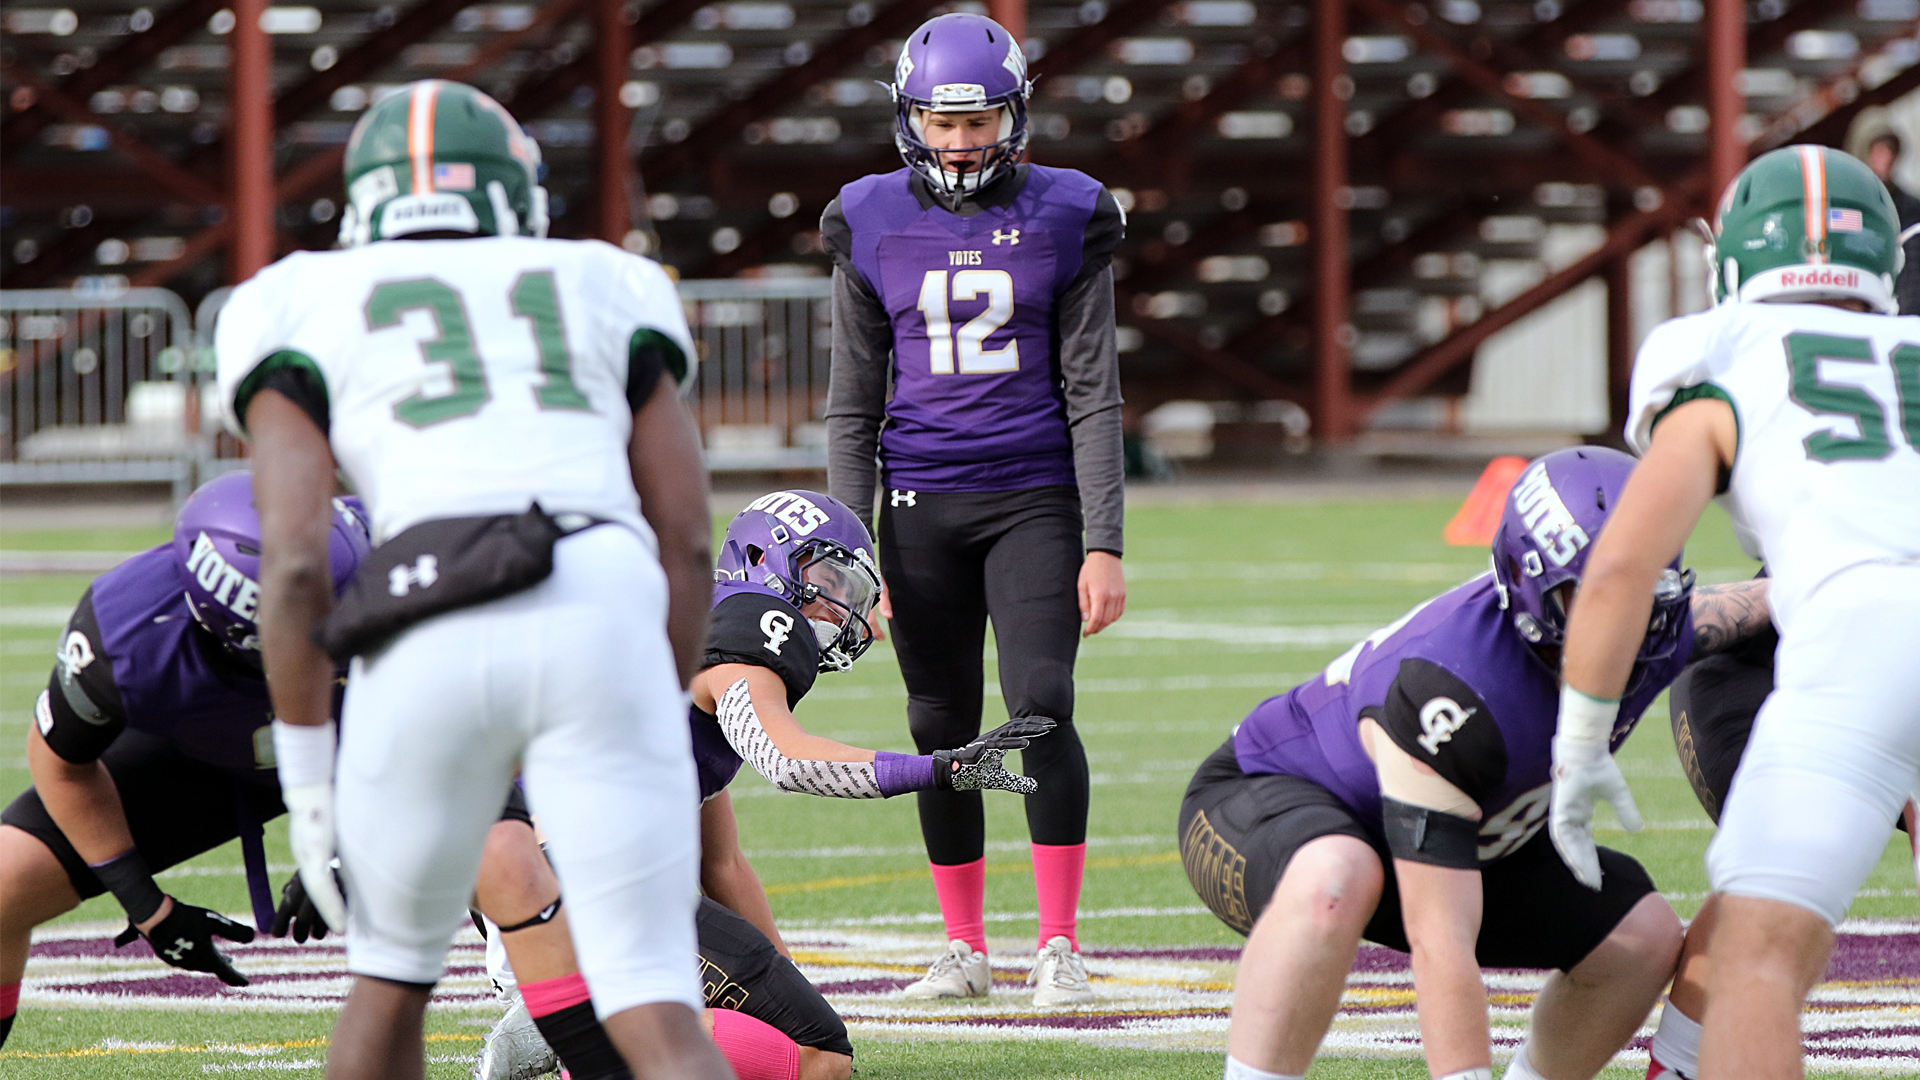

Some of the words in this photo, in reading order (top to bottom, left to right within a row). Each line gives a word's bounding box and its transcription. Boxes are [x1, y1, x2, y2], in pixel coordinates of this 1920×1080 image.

[948, 250, 982, 266] YOTES
[1781, 269, 1859, 288] Riddell
[363, 268, 601, 432] 31
[917, 269, 1020, 374] 12
